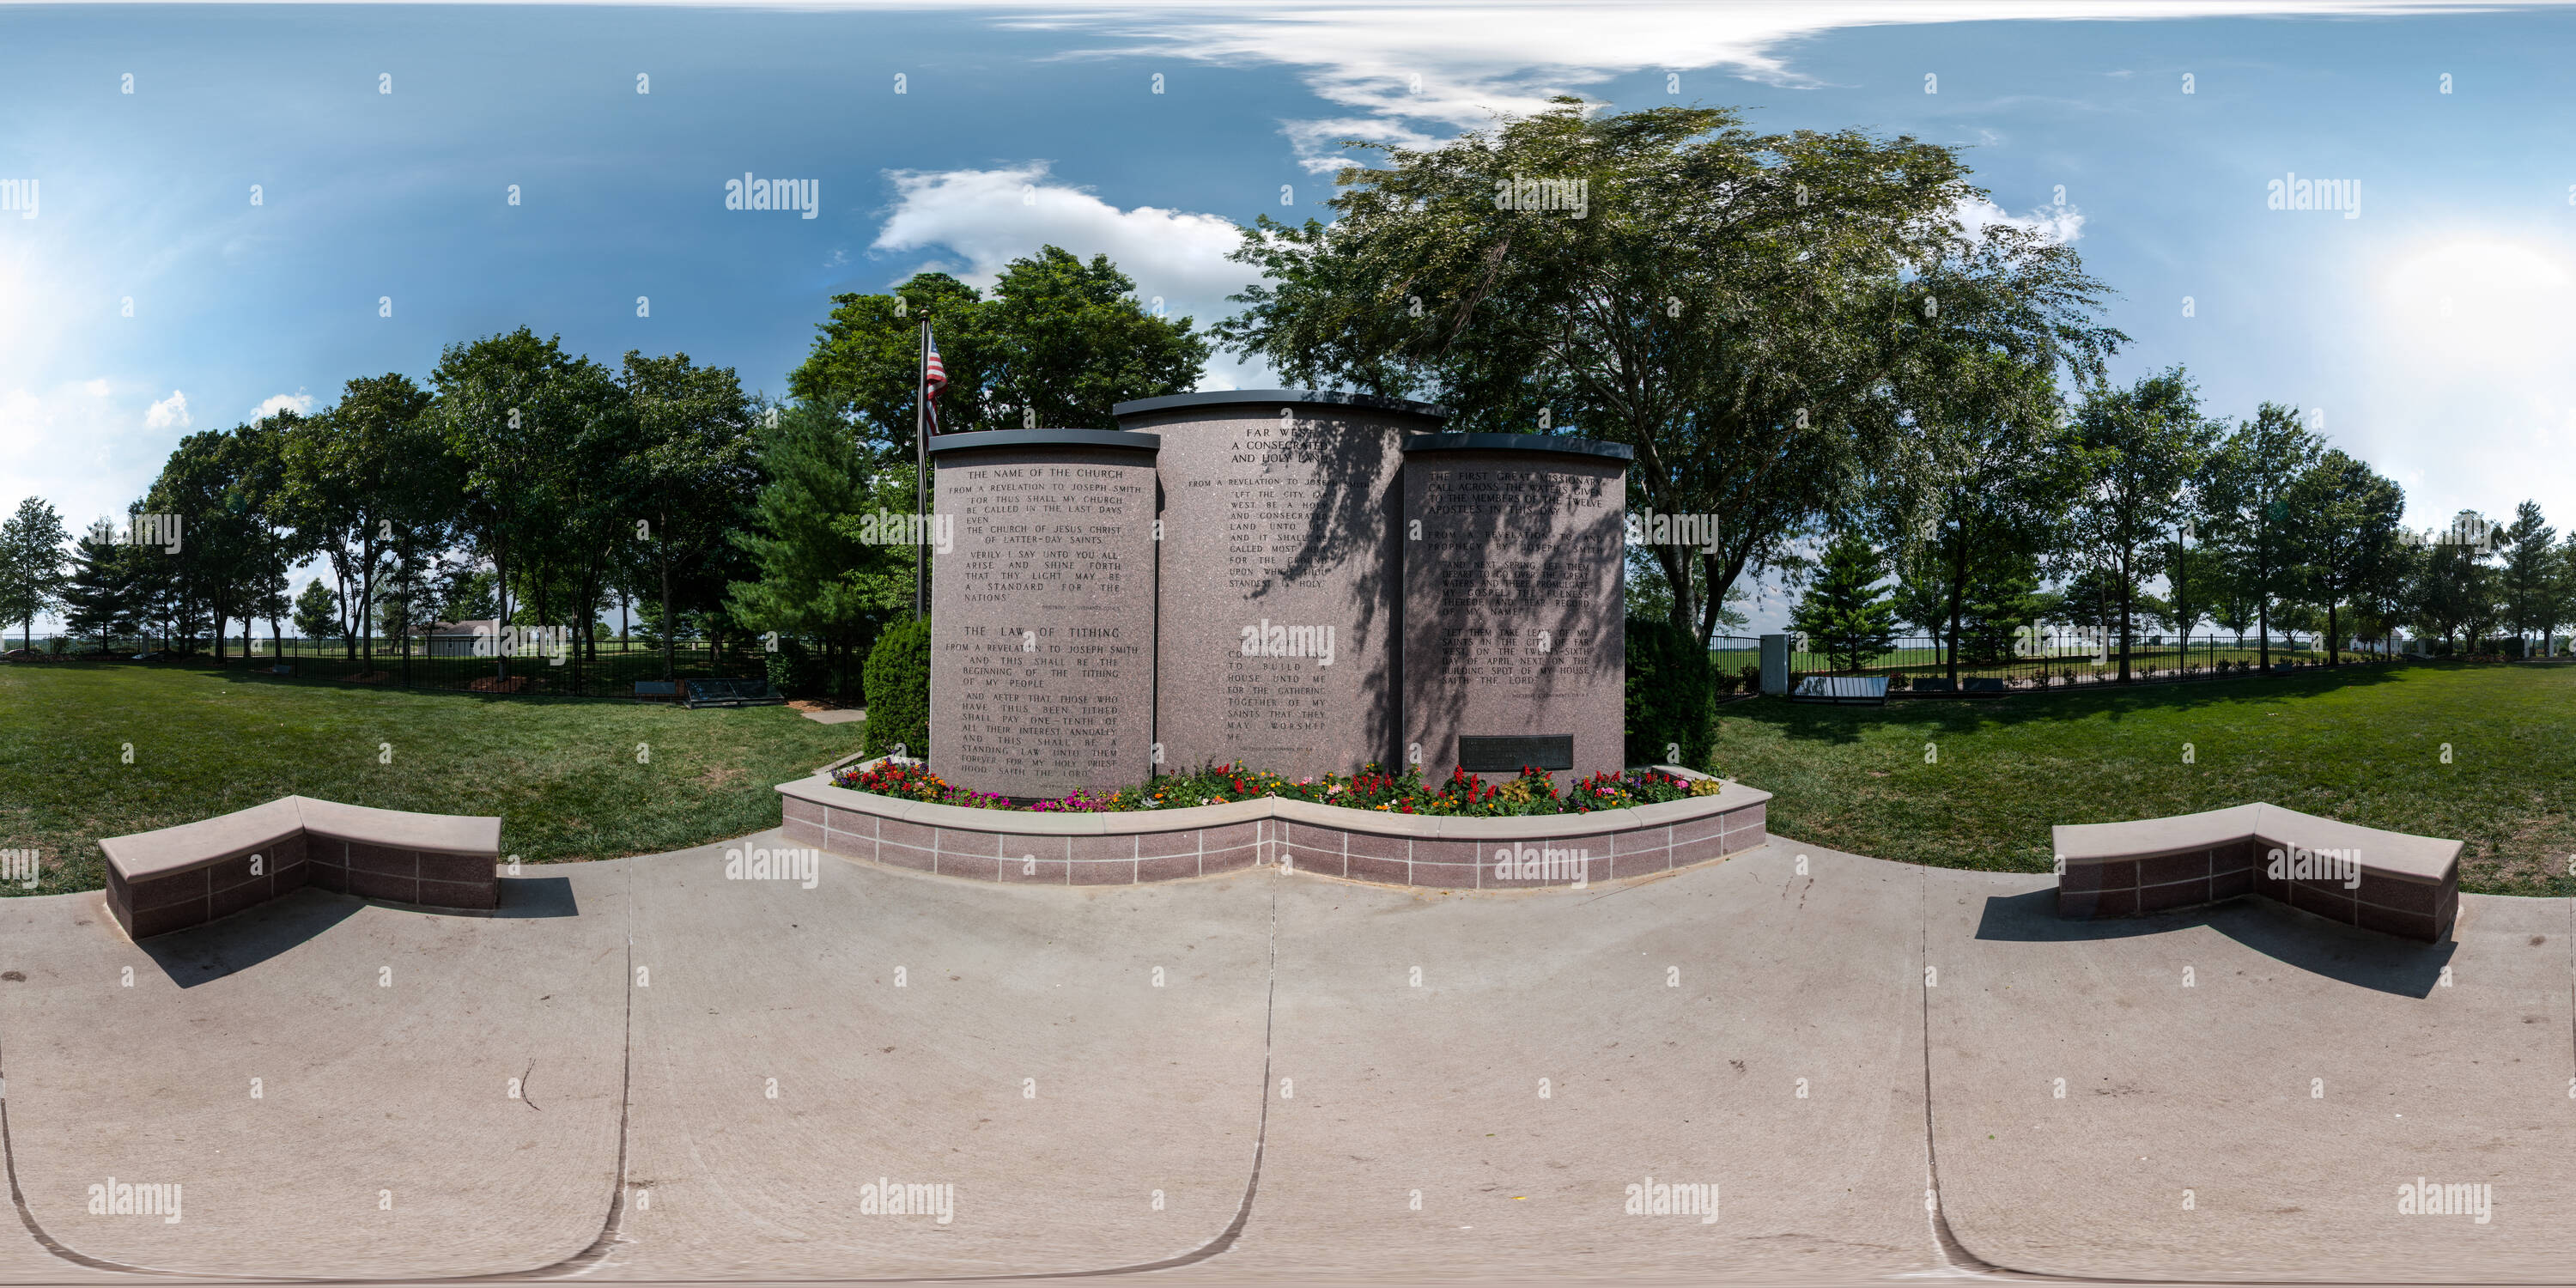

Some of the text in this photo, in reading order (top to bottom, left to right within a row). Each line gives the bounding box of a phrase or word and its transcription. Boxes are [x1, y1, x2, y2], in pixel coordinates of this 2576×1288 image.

[1280, 428, 1315, 437] WEST
[1247, 441, 1327, 450] CONSECRATED
[1077, 470, 1123, 479] CHURCH
[1540, 474, 1601, 486] MISSIONARY
[1114, 485, 1141, 494] SMITH
[1429, 483, 1453, 492] CALL
[1530, 484, 1568, 495] WATERS
[1573, 487, 1602, 497] GIVEN
[1474, 494, 1519, 503] MEMBERS
[1525, 495, 1537, 503] OF
[1544, 495, 1562, 504] THE
[1566, 496, 1602, 507] TWELVE
[964, 627, 1120, 638] THE LAW OF TITHING
[963, 667, 1012, 676] BEGINNING
